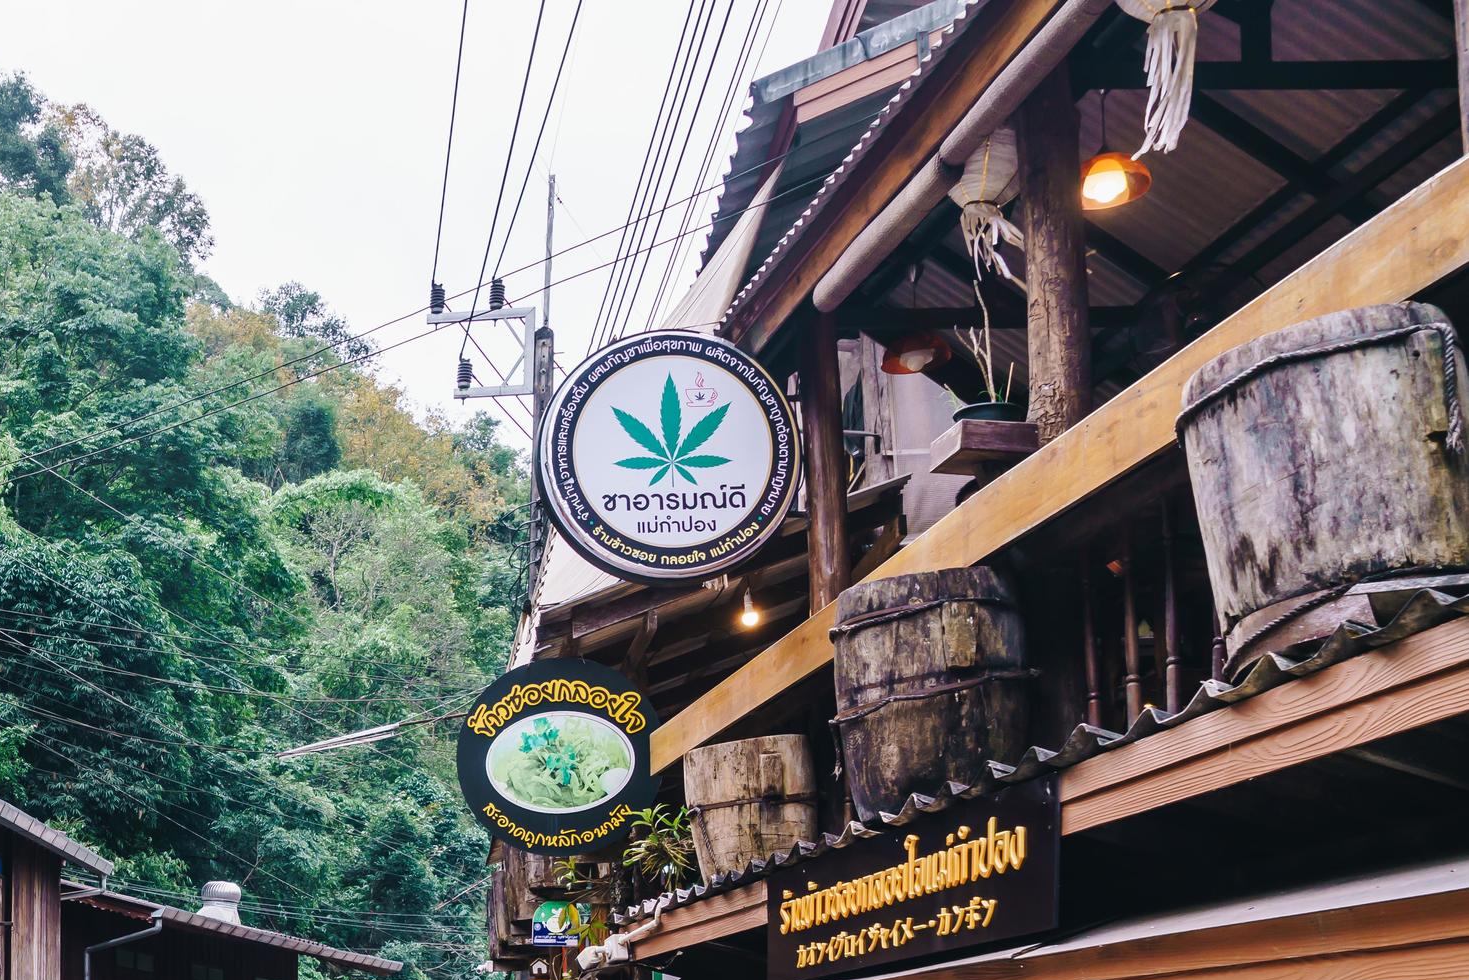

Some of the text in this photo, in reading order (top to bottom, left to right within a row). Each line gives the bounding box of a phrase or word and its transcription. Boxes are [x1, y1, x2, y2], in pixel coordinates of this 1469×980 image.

[588, 337, 702, 382] ผสมกัญชาเพื่อสุขภาพ
[602, 484, 747, 511] ชาอารมณ์ดี
[592, 521, 760, 565] ร้านข้าวซอย กลอยใจ แม่กำปอง
[637, 515, 717, 534] แม่กำปอง
[467, 679, 646, 736] ข้าวซอยกลอยใจ
[483, 802, 633, 848] สะอาดถูกหลักอนามัย
